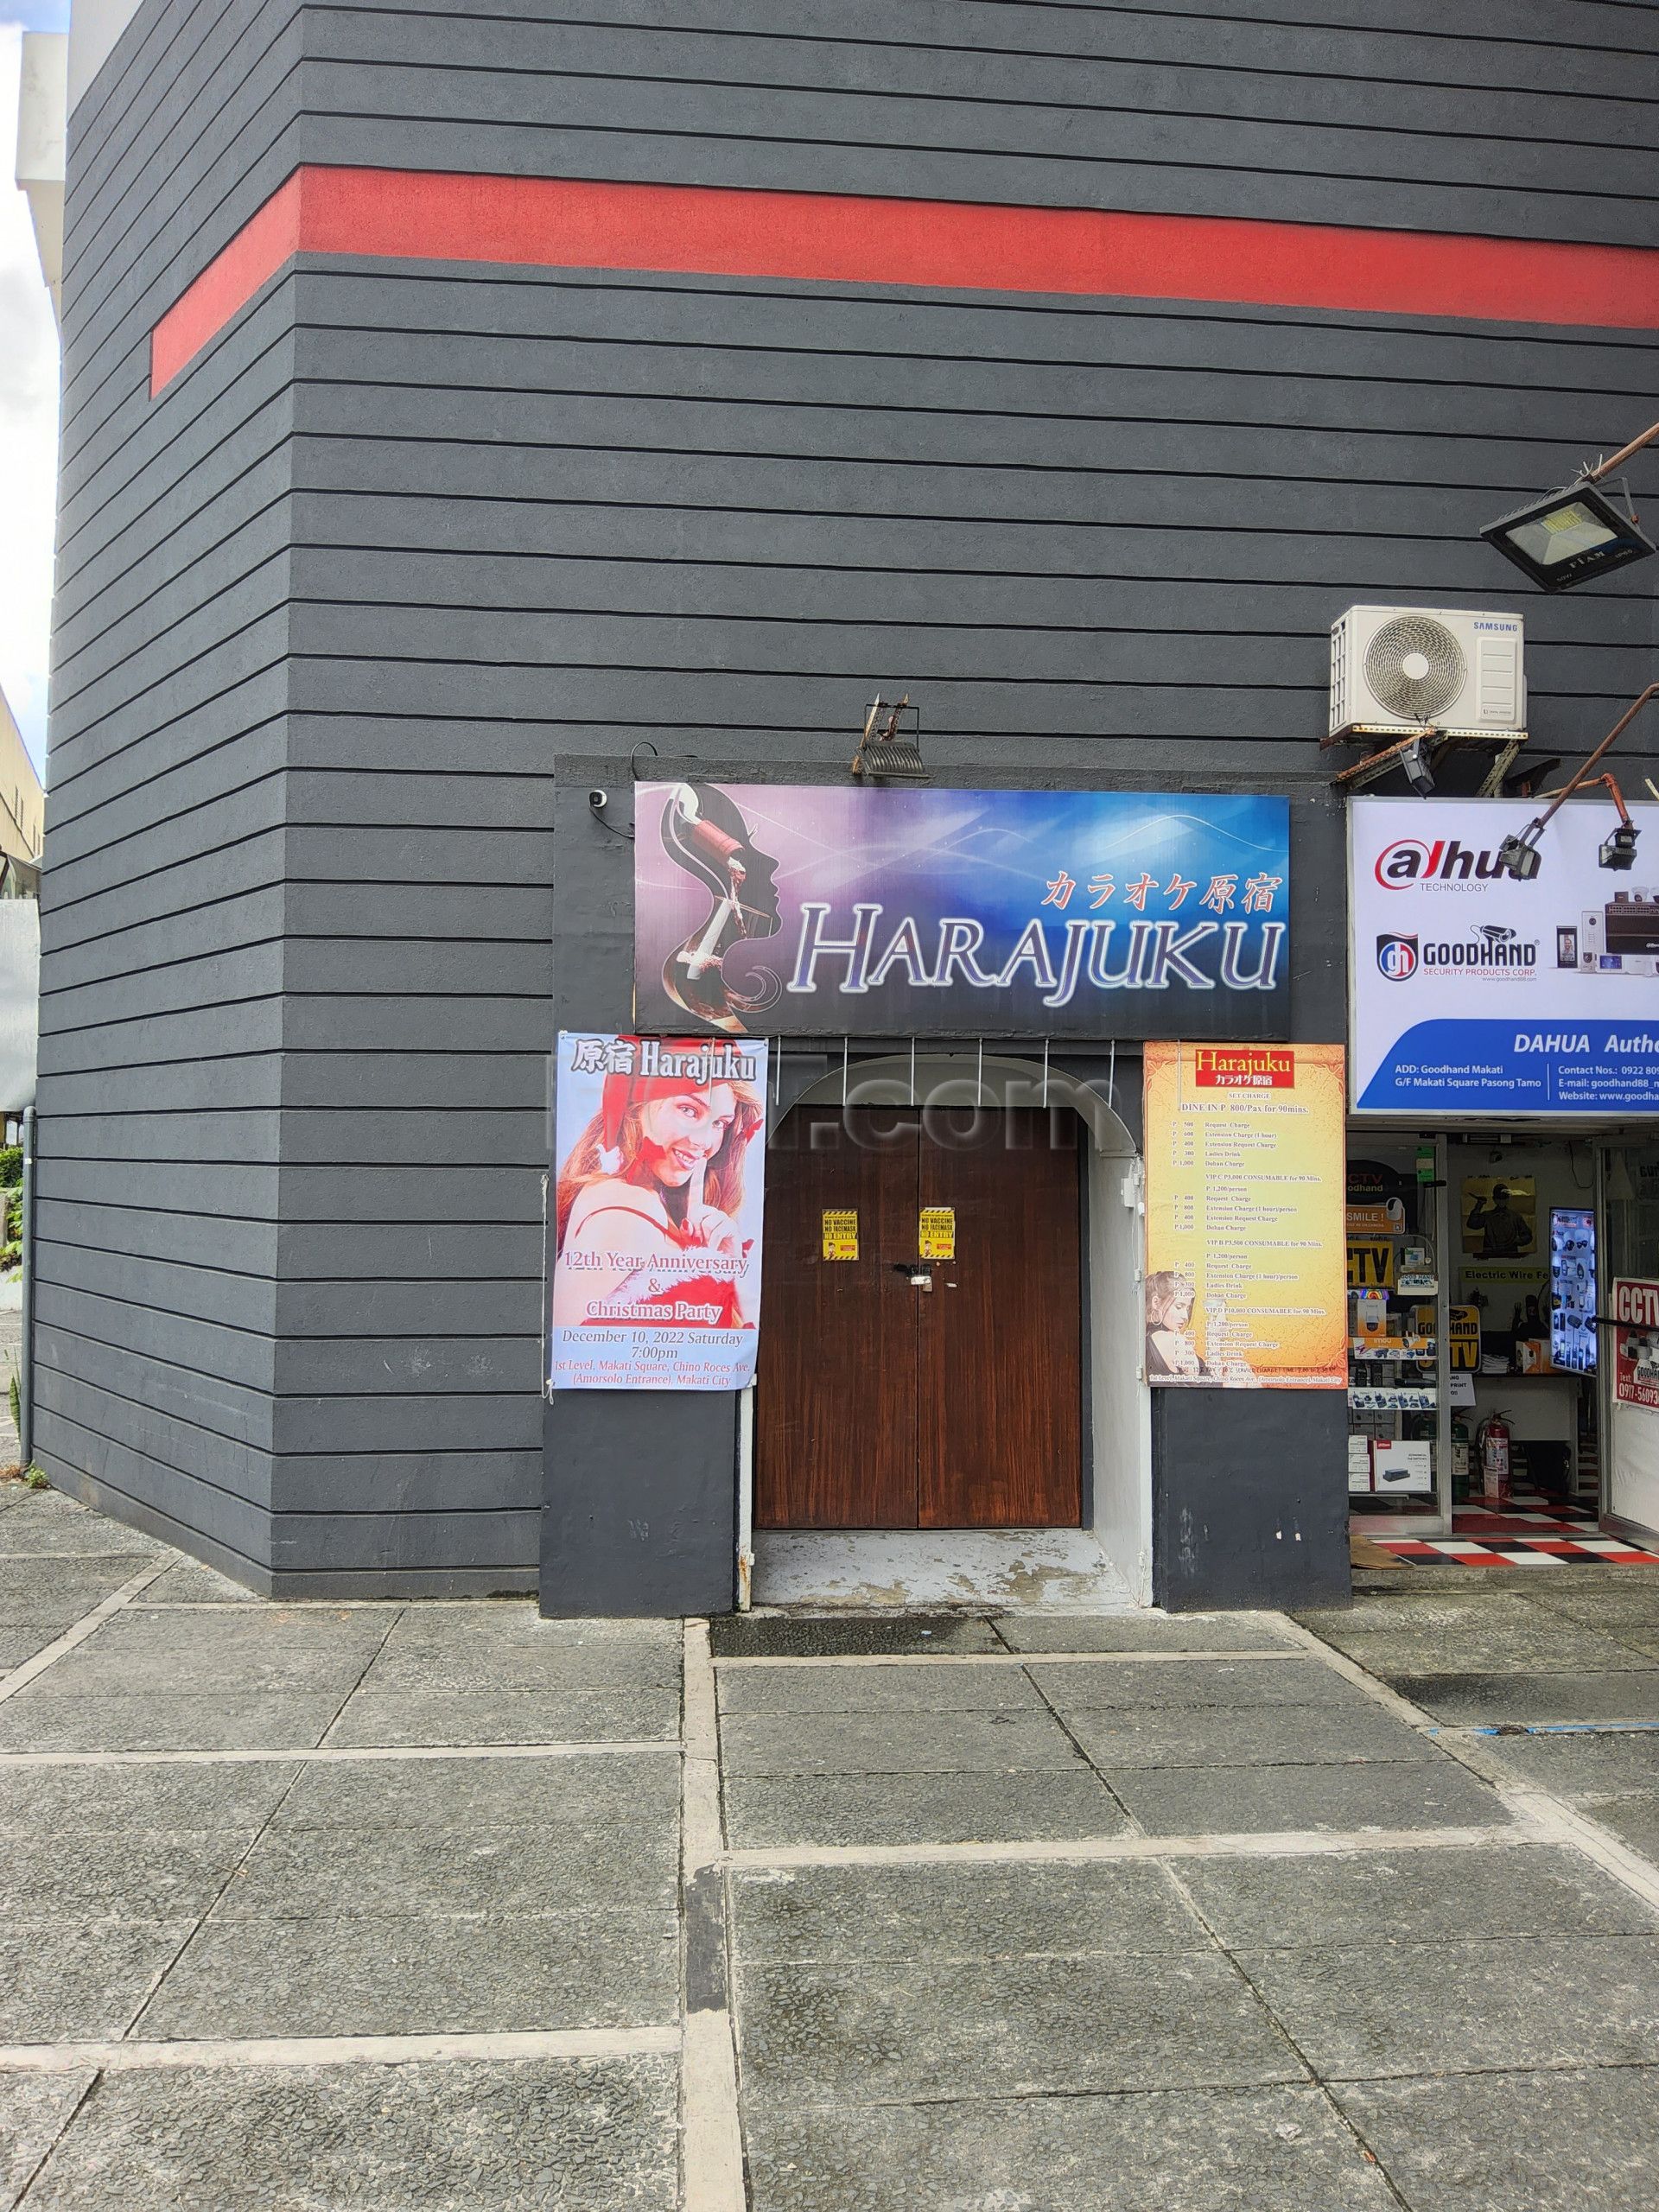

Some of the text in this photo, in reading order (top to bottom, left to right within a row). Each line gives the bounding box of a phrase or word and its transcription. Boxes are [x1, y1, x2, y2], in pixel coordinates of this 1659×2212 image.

[1473, 621, 1518, 632] SAMSUNG
[1040, 872, 1282, 915] カラオケ原宿
[786, 902, 1286, 1008] HARAJUKU
[1423, 943, 1536, 966] GOODHAND
[1514, 1034, 1590, 1052] DAHUA
[571, 1039, 636, 1074] 原宿
[639, 1040, 756, 1084] Harajuku
[1196, 1051, 1291, 1076] Harajuku
[1215, 1075, 1273, 1086] カラオケ原宿
[1395, 1078, 1411, 1087] G/F
[1414, 1078, 1445, 1087] Makati
[1447, 1078, 1478, 1089] Square
[1482, 1079, 1514, 1089] Pasong
[1559, 1091, 1598, 1100] Website:
[1347, 1212, 1378, 1221] SMILE
[565, 1252, 747, 1274] 12th Year Anniversary
[648, 1278, 661, 1293] &
[587, 1301, 721, 1322] Christmas Party
[563, 1331, 742, 1347] December 10, 2022 Saturday
[631, 1347, 678, 1361] 7:00pm
[555, 1360, 750, 1373] 1st Level, Makati Square, Chino Roces Ave.
[574, 1373, 622, 1384] (Amorsolo
[677, 1375, 709, 1384] Makati
[712, 1376, 730, 1387] City
